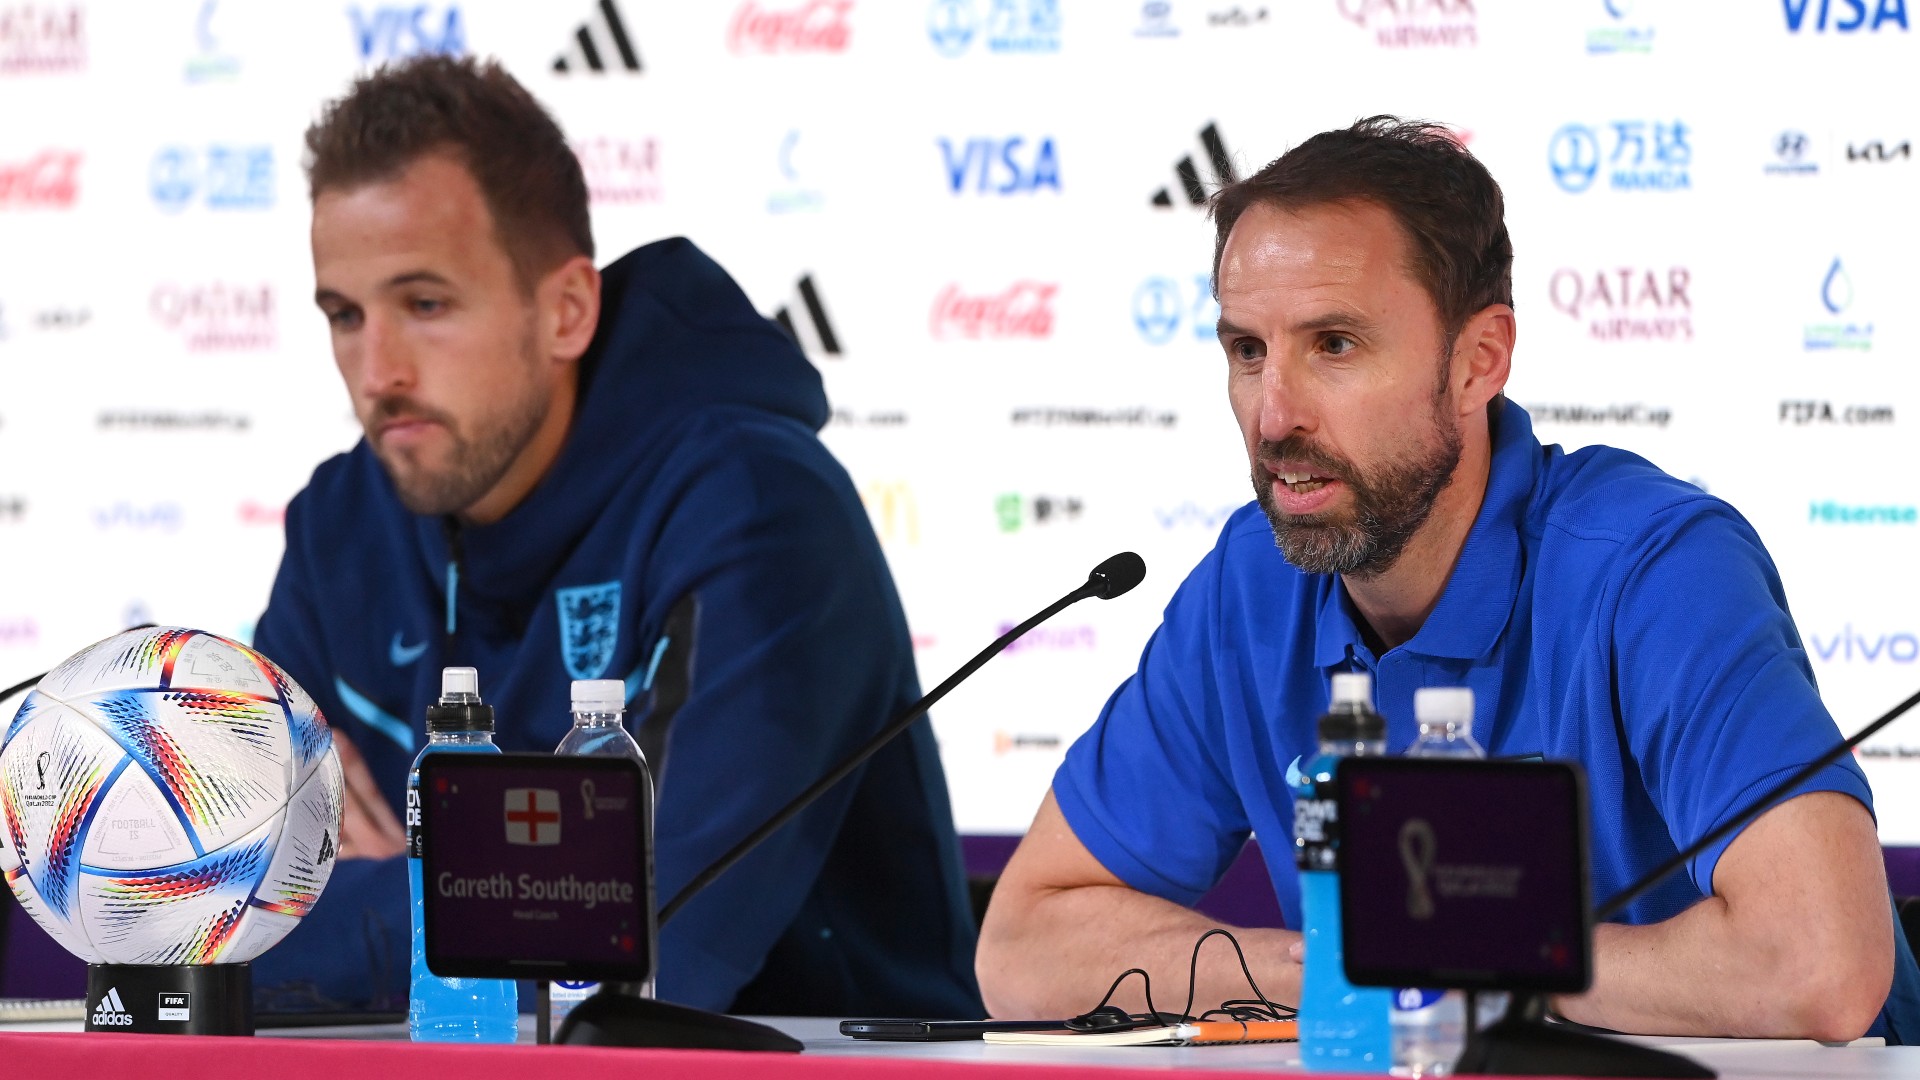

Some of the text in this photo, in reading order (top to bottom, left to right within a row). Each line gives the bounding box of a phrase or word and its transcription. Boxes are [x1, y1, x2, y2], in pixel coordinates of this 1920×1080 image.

[937, 136, 1062, 195] VISA
[1549, 266, 1692, 320] QATAR
[1778, 400, 1895, 426] FIFA.com
[1811, 622, 1920, 663] vivo
[111, 819, 157, 830] FOOTBALL
[438, 872, 634, 909] Gareth Southgate
[164, 997, 185, 1005] FIFA
[92, 1010, 133, 1026] adidas
